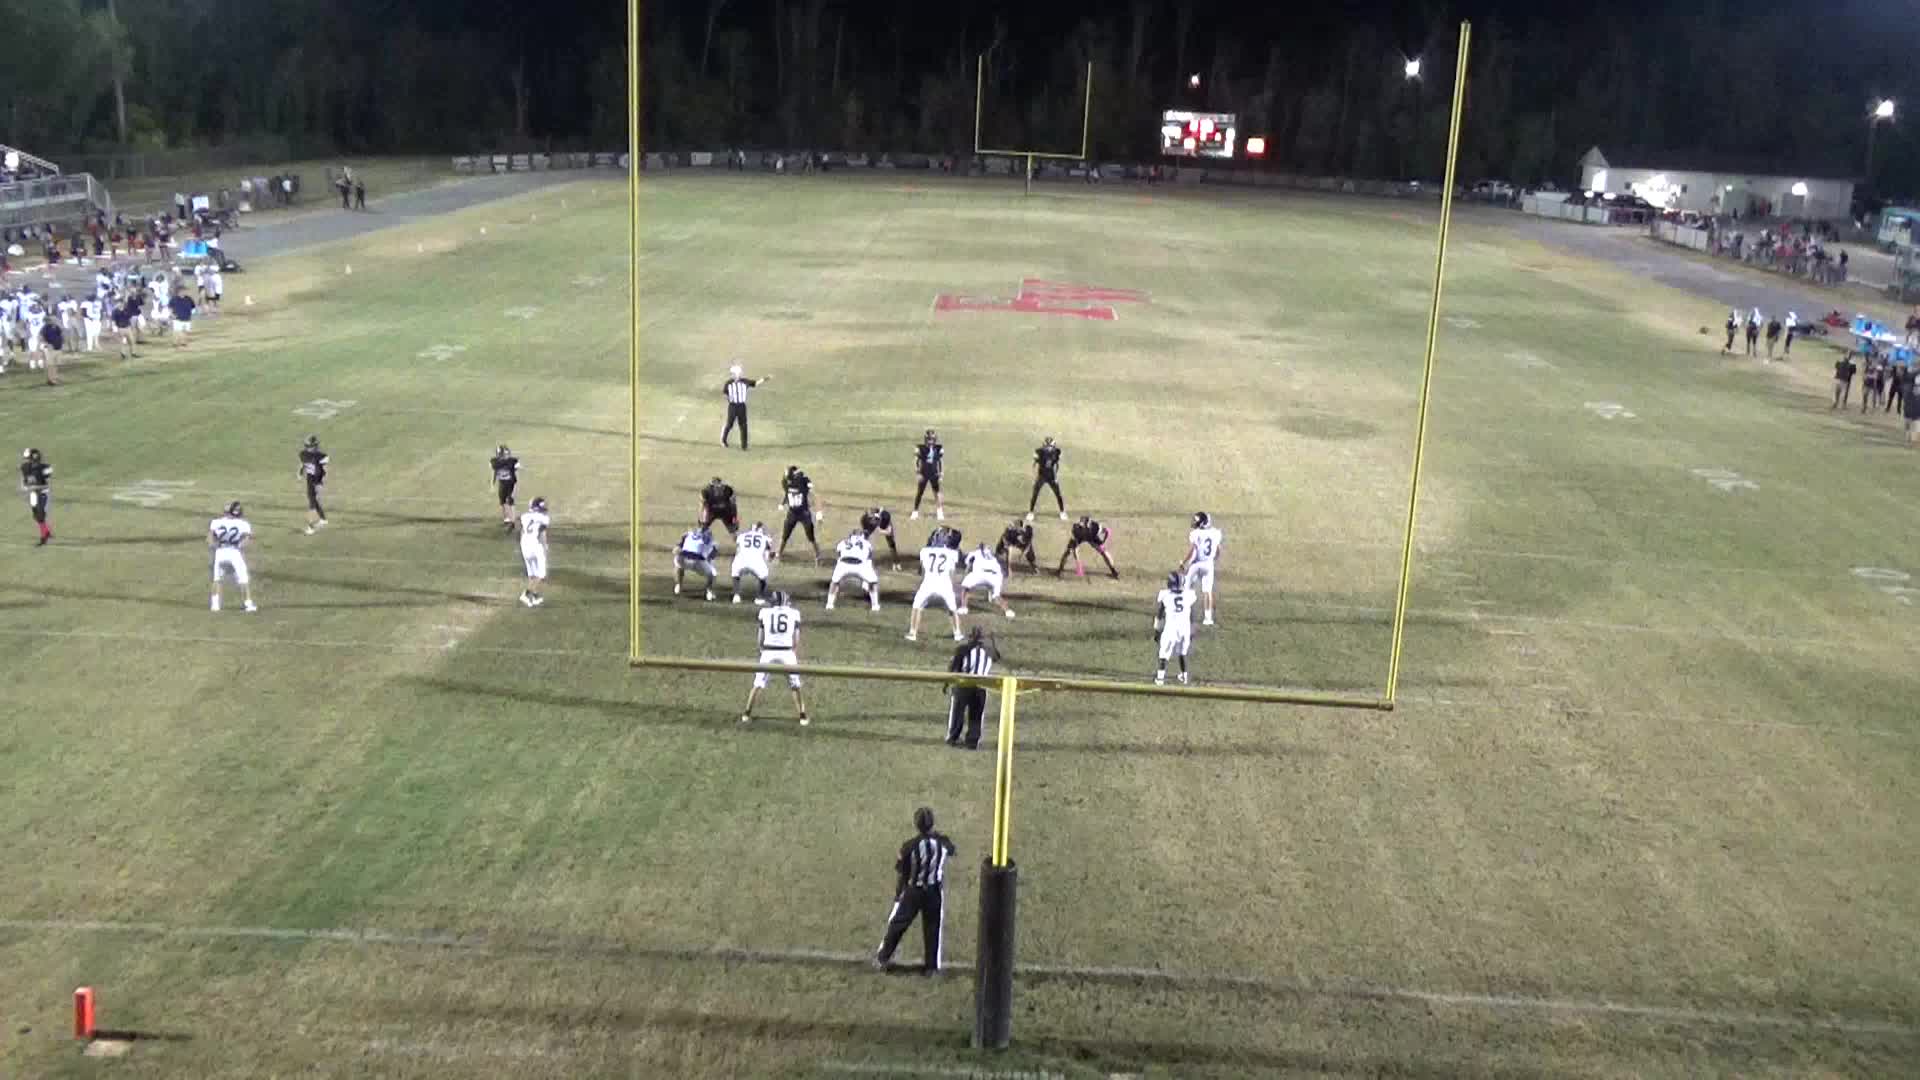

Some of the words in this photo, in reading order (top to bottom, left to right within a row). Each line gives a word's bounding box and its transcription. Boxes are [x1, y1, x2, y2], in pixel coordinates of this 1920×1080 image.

[217, 525, 241, 545] 22
[743, 534, 763, 549] 56
[928, 552, 947, 574] 72
[1173, 596, 1184, 613] 5
[770, 613, 788, 635] 16
